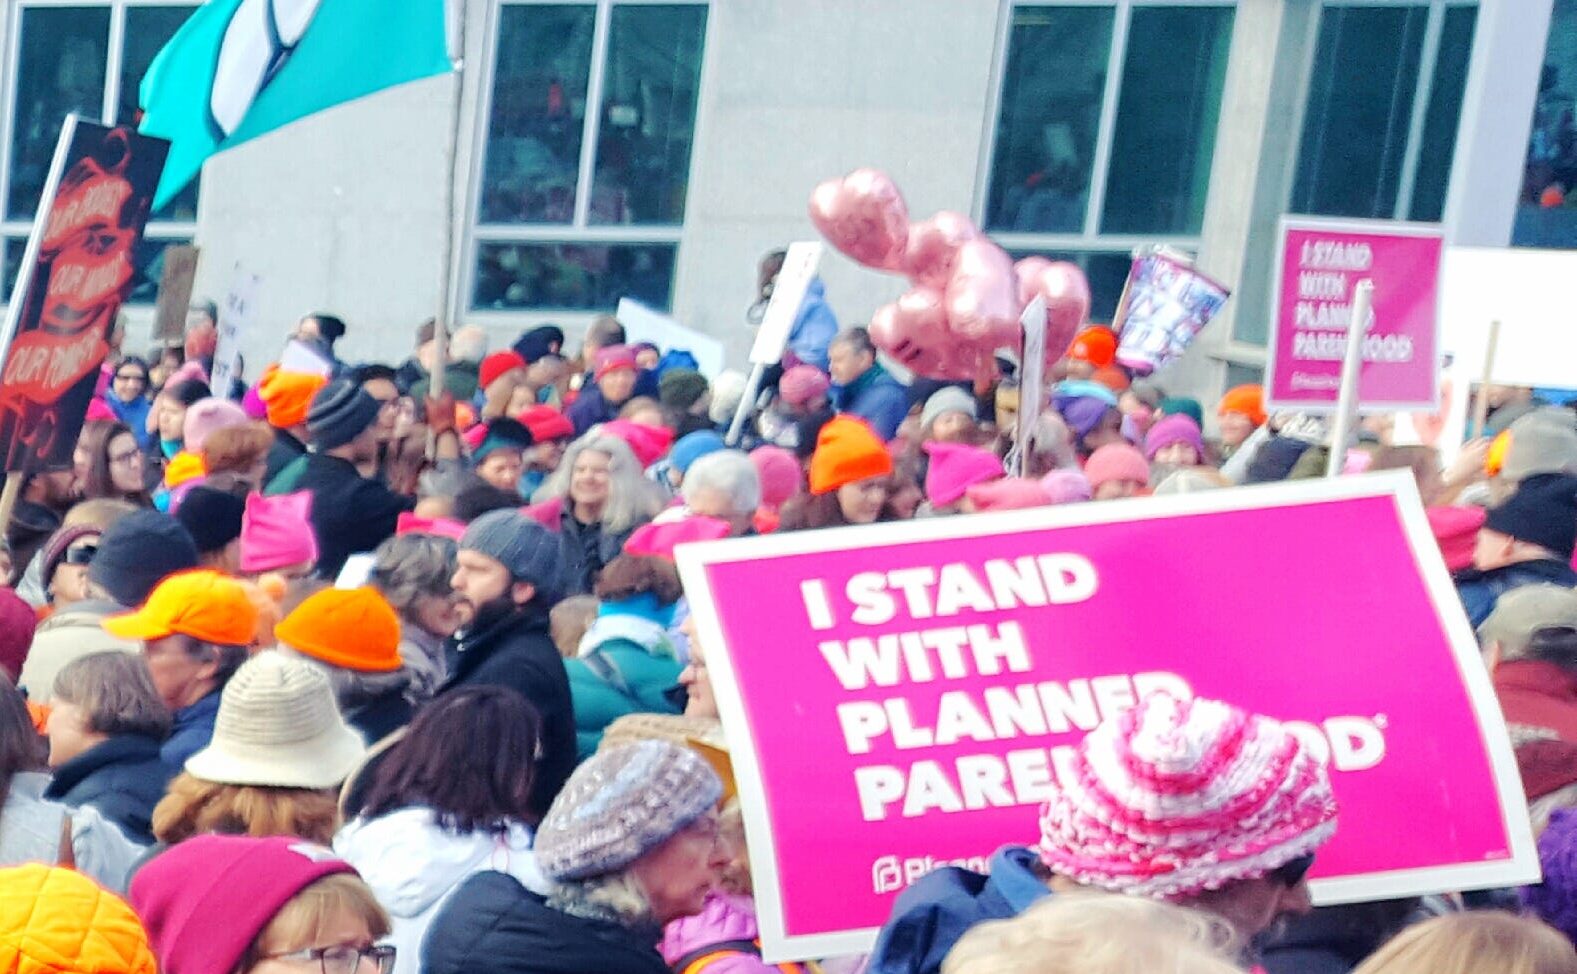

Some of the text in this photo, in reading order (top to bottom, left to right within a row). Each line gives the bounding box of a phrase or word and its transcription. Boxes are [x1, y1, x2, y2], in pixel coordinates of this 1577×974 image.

[1312, 241, 1373, 271] STAND
[1299, 270, 1346, 300] WITH
[4, 346, 47, 385] OUR
[800, 552, 1098, 631] I STAND
[818, 620, 1031, 690] WITH
